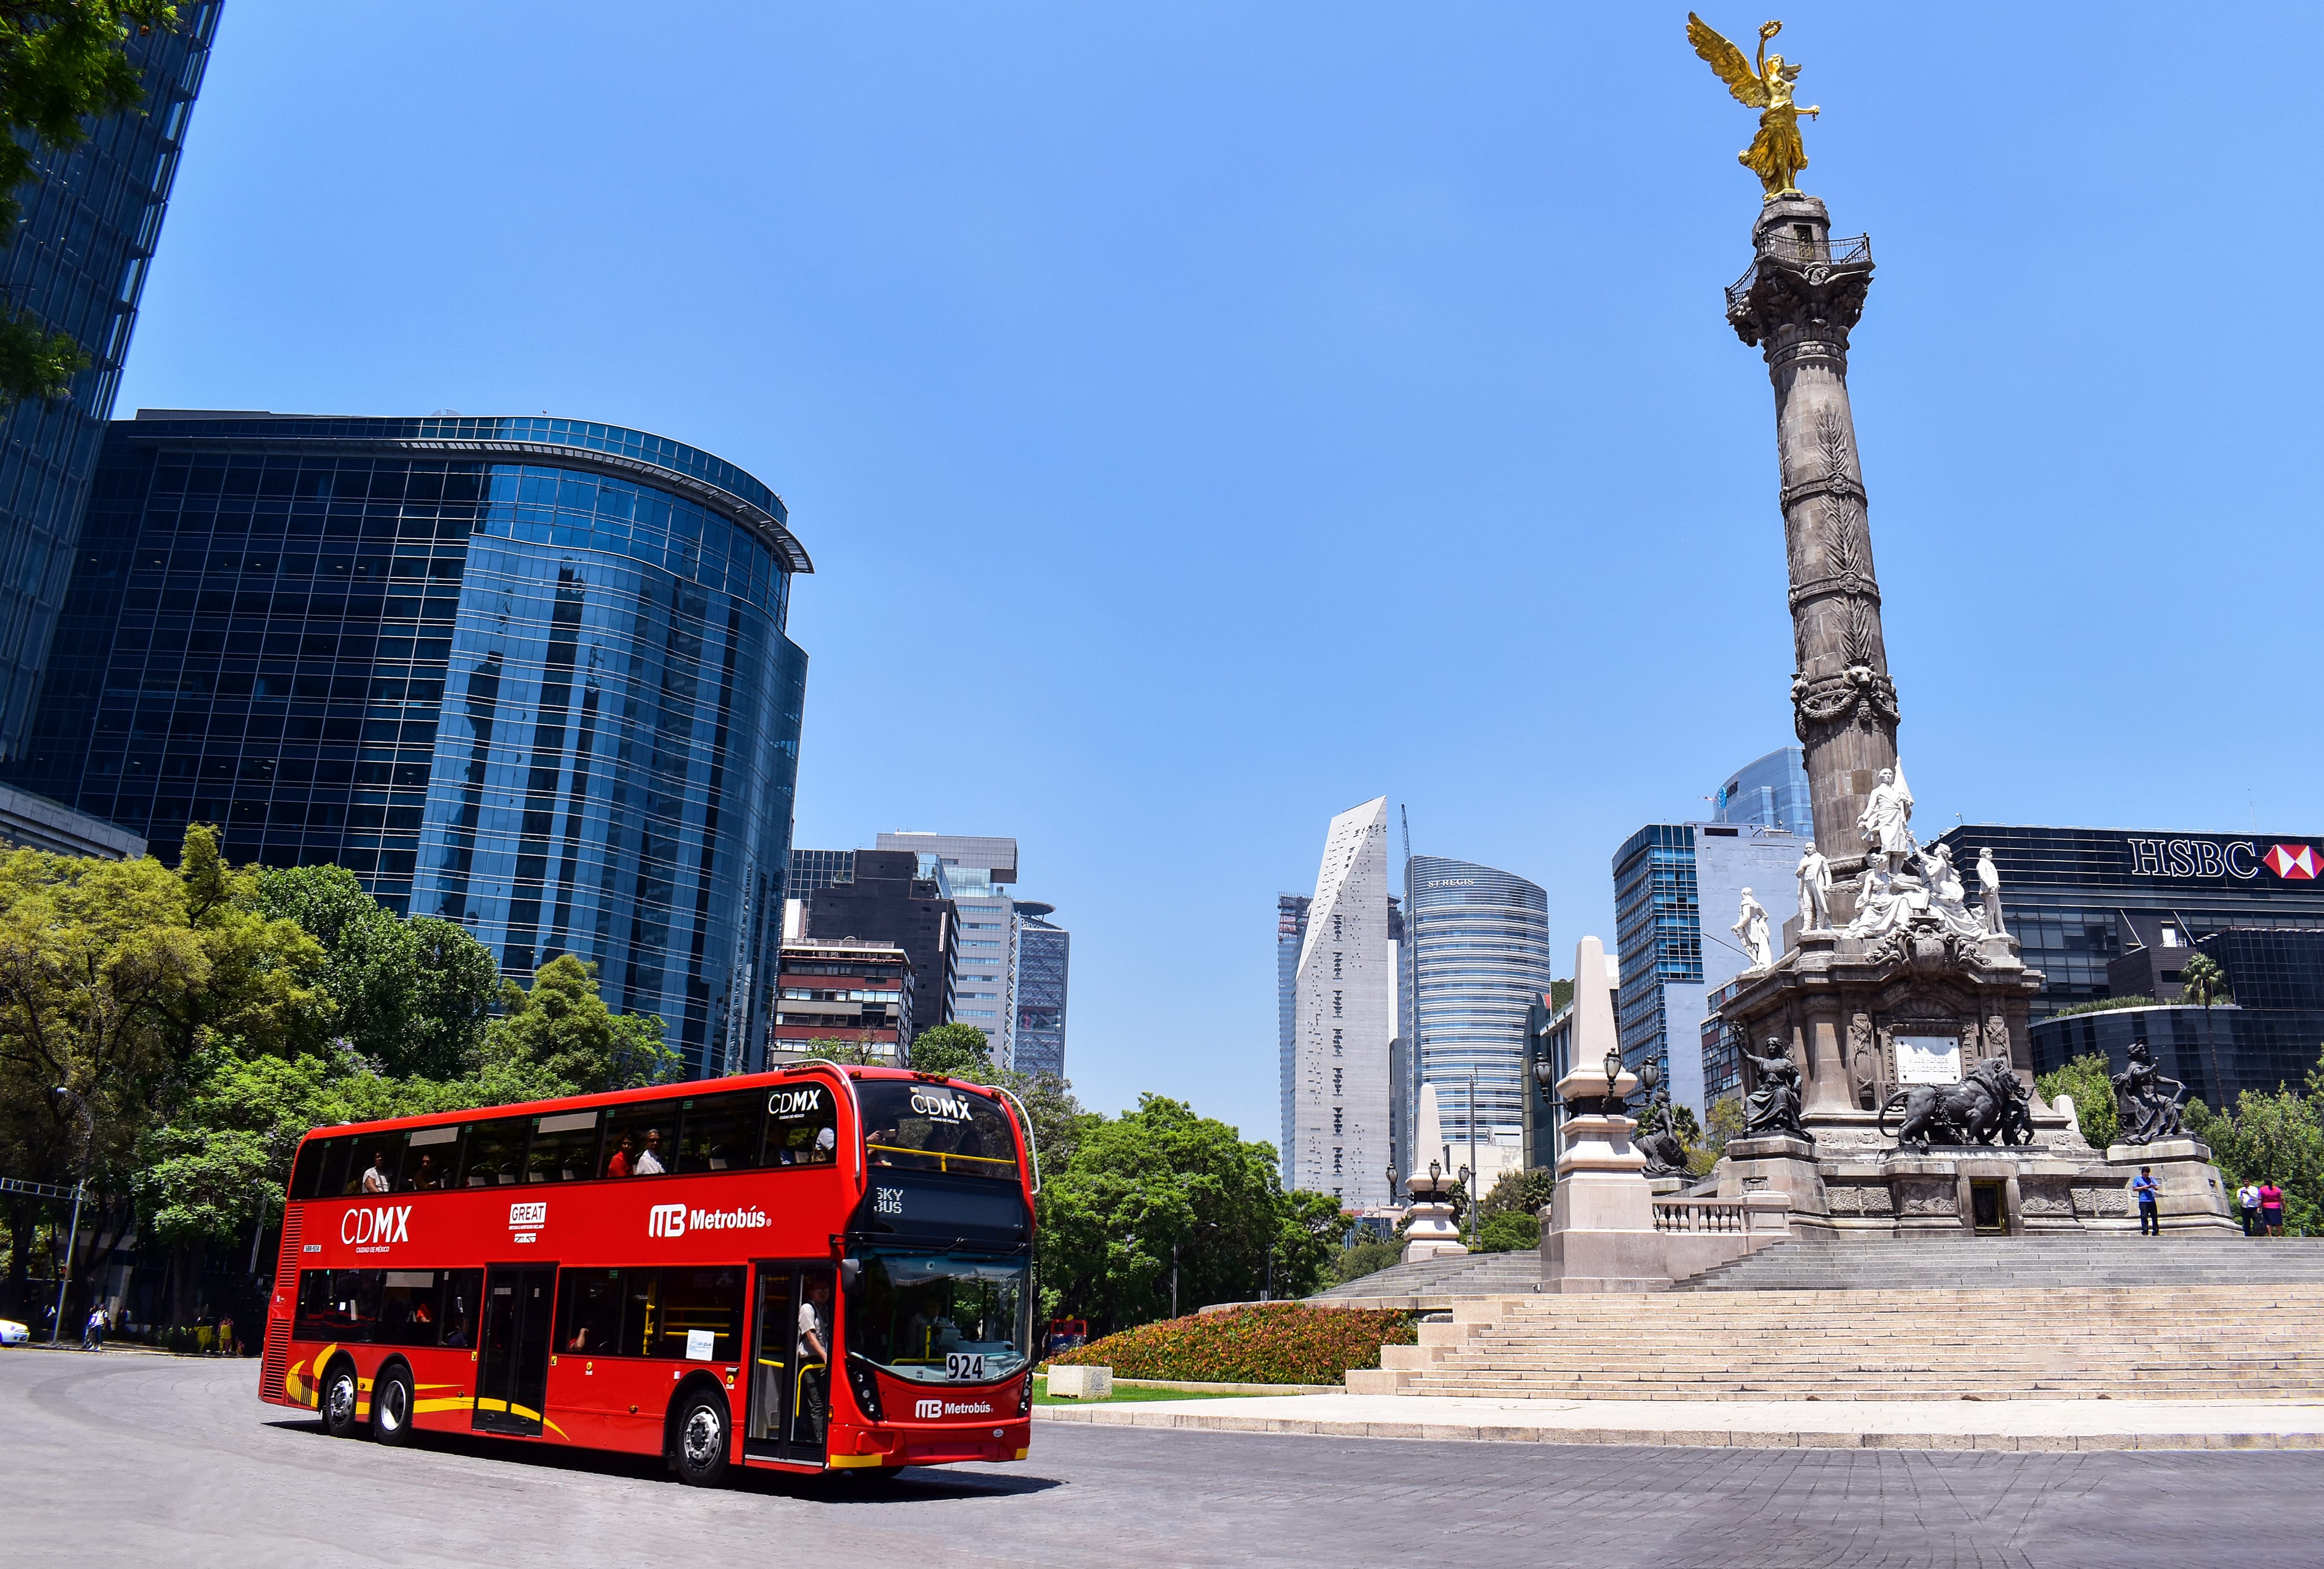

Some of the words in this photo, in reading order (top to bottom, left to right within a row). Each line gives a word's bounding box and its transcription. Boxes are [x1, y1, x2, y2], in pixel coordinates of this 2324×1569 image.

[2127, 838, 2259, 879] HSBC
[768, 1089, 821, 1114] CDMX
[911, 1094, 973, 1121] CDMX
[341, 1205, 412, 1245] CDMX
[512, 1205, 545, 1221] GREAT
[649, 1203, 687, 1238] MB
[690, 1205, 766, 1230] Metrobús
[948, 1355, 983, 1379] 924
[915, 1400, 943, 1418] MB
[945, 1401, 991, 1414] Metrobús
